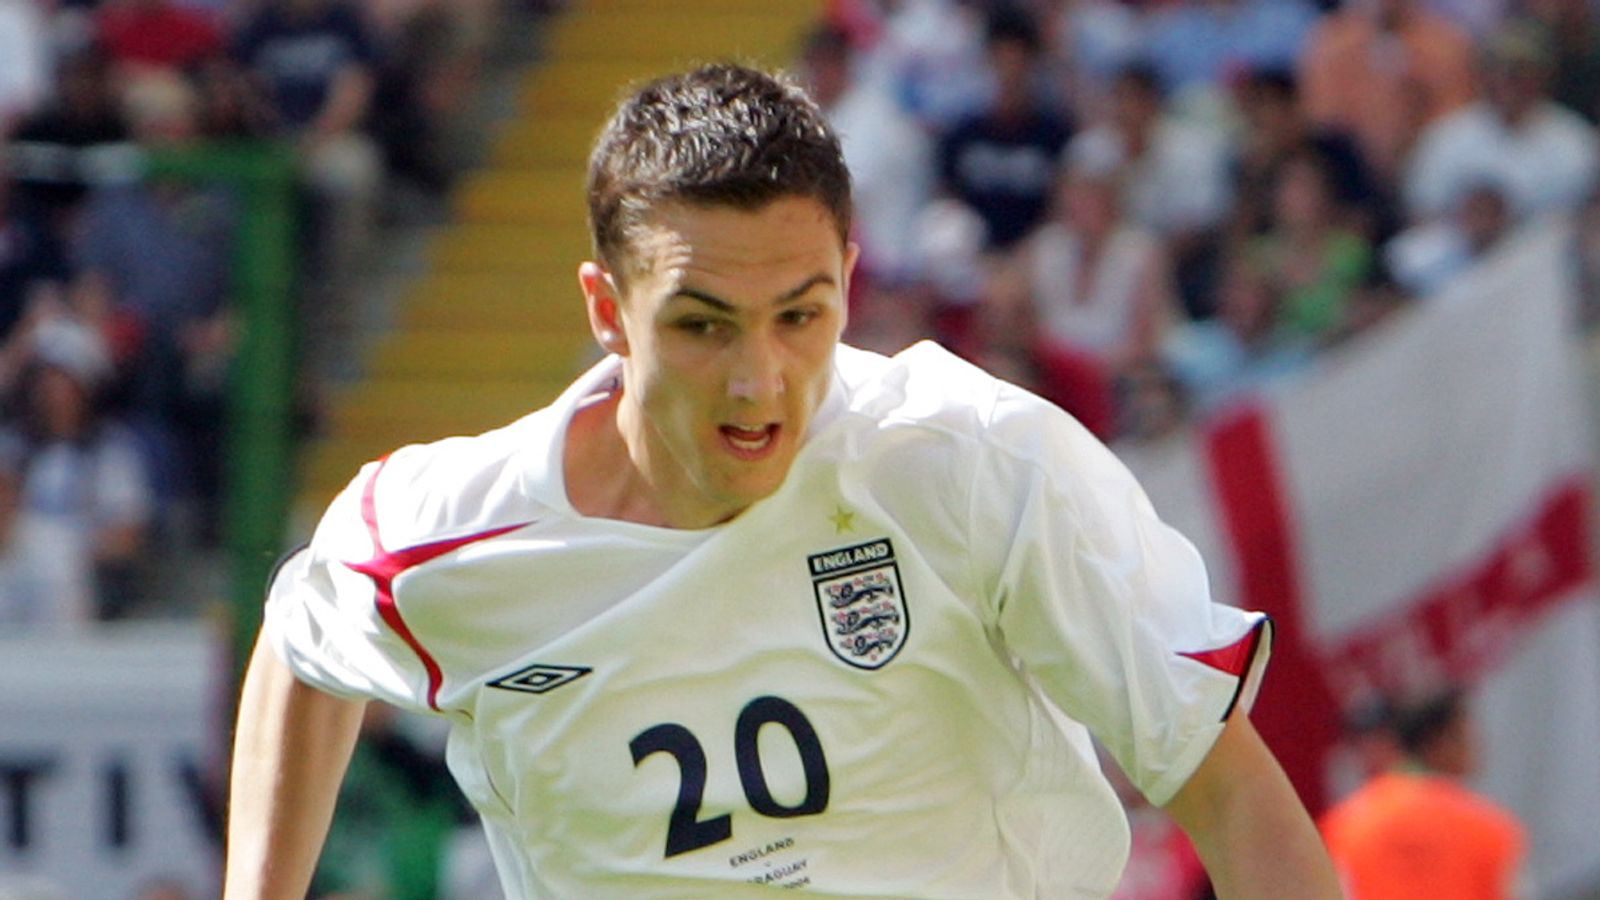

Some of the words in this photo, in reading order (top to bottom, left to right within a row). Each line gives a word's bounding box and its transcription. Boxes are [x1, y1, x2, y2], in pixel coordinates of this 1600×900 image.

[813, 541, 889, 573] ENGLAND
[629, 695, 830, 860] 20
[729, 837, 794, 868] ENGLAND
[746, 858, 807, 884] RAGUAY
